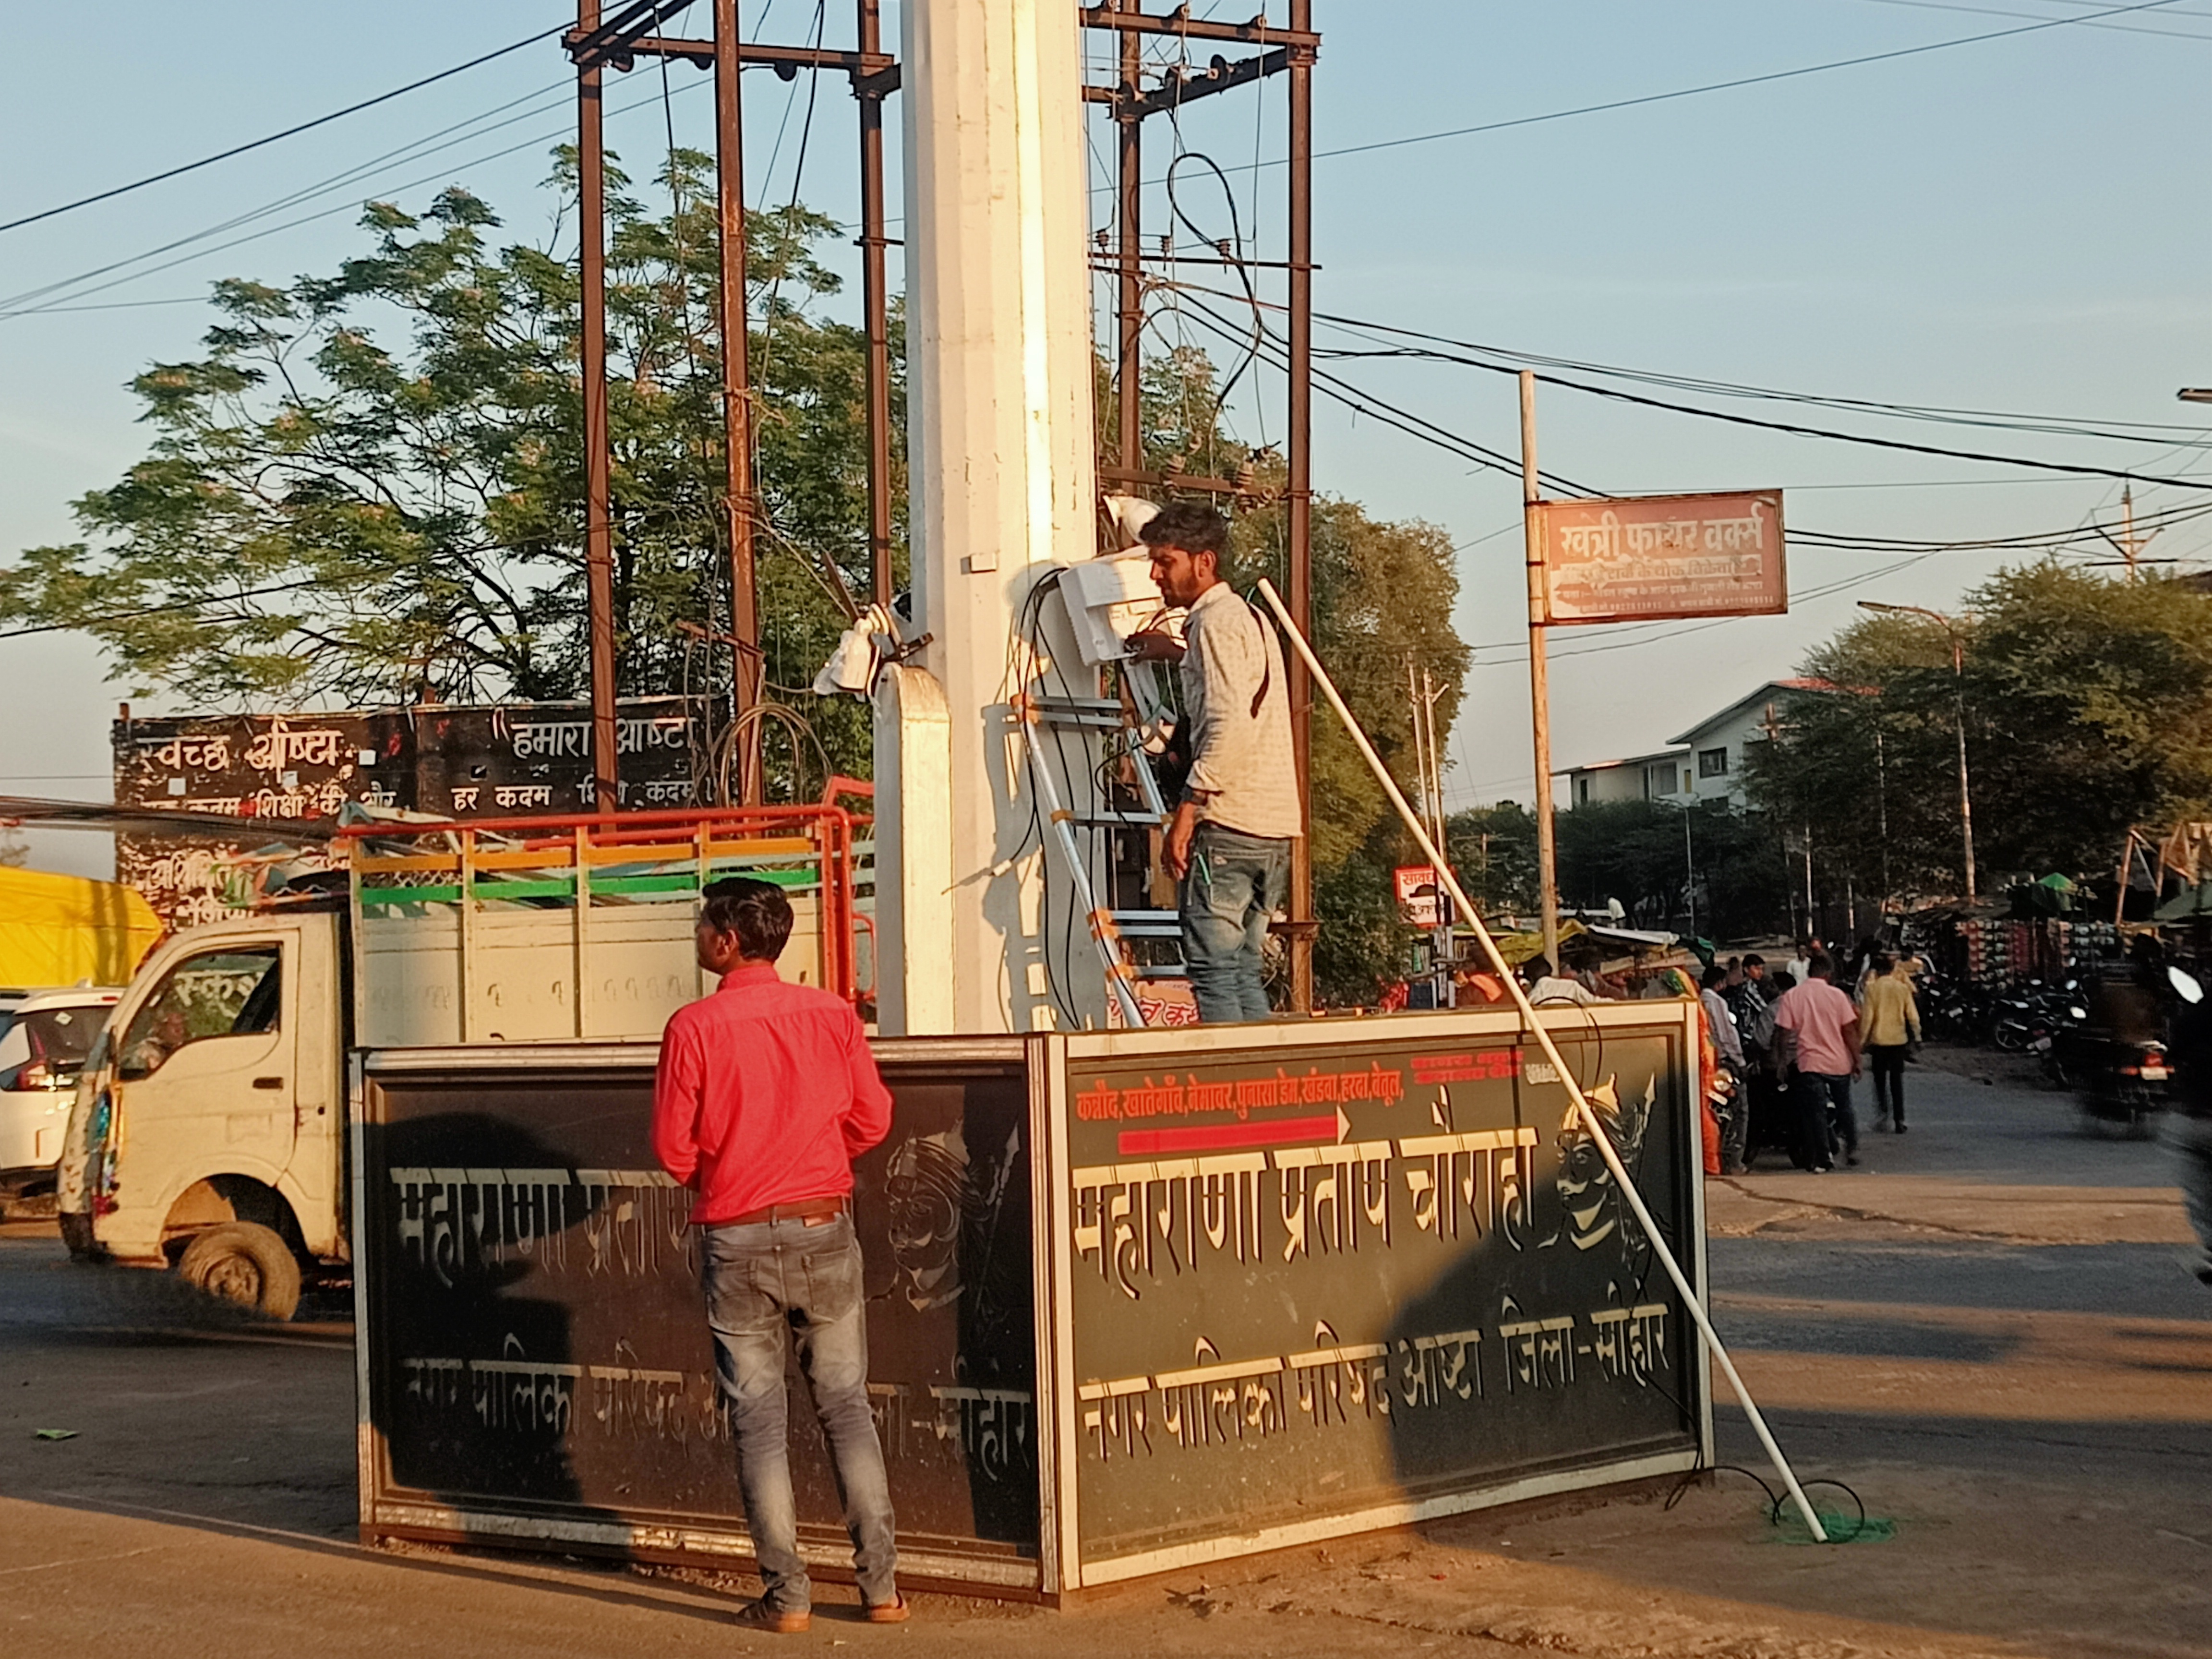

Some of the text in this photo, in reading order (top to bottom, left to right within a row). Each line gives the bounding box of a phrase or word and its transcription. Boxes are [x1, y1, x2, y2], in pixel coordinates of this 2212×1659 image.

[510, 721, 593, 758] हमारा
[451, 787, 479, 811] हर
[495, 785, 553, 806] कदम
[1402, 872, 1435, 885] सावध
[388, 1166, 572, 1289] महाराणा
[1072, 1083, 1539, 1300] महाराणा प्रताप चौराहा
[1078, 1375, 1152, 1462] नगर
[1154, 1335, 1286, 1450] पालिका
[1398, 1328, 1483, 1409] आष्टा
